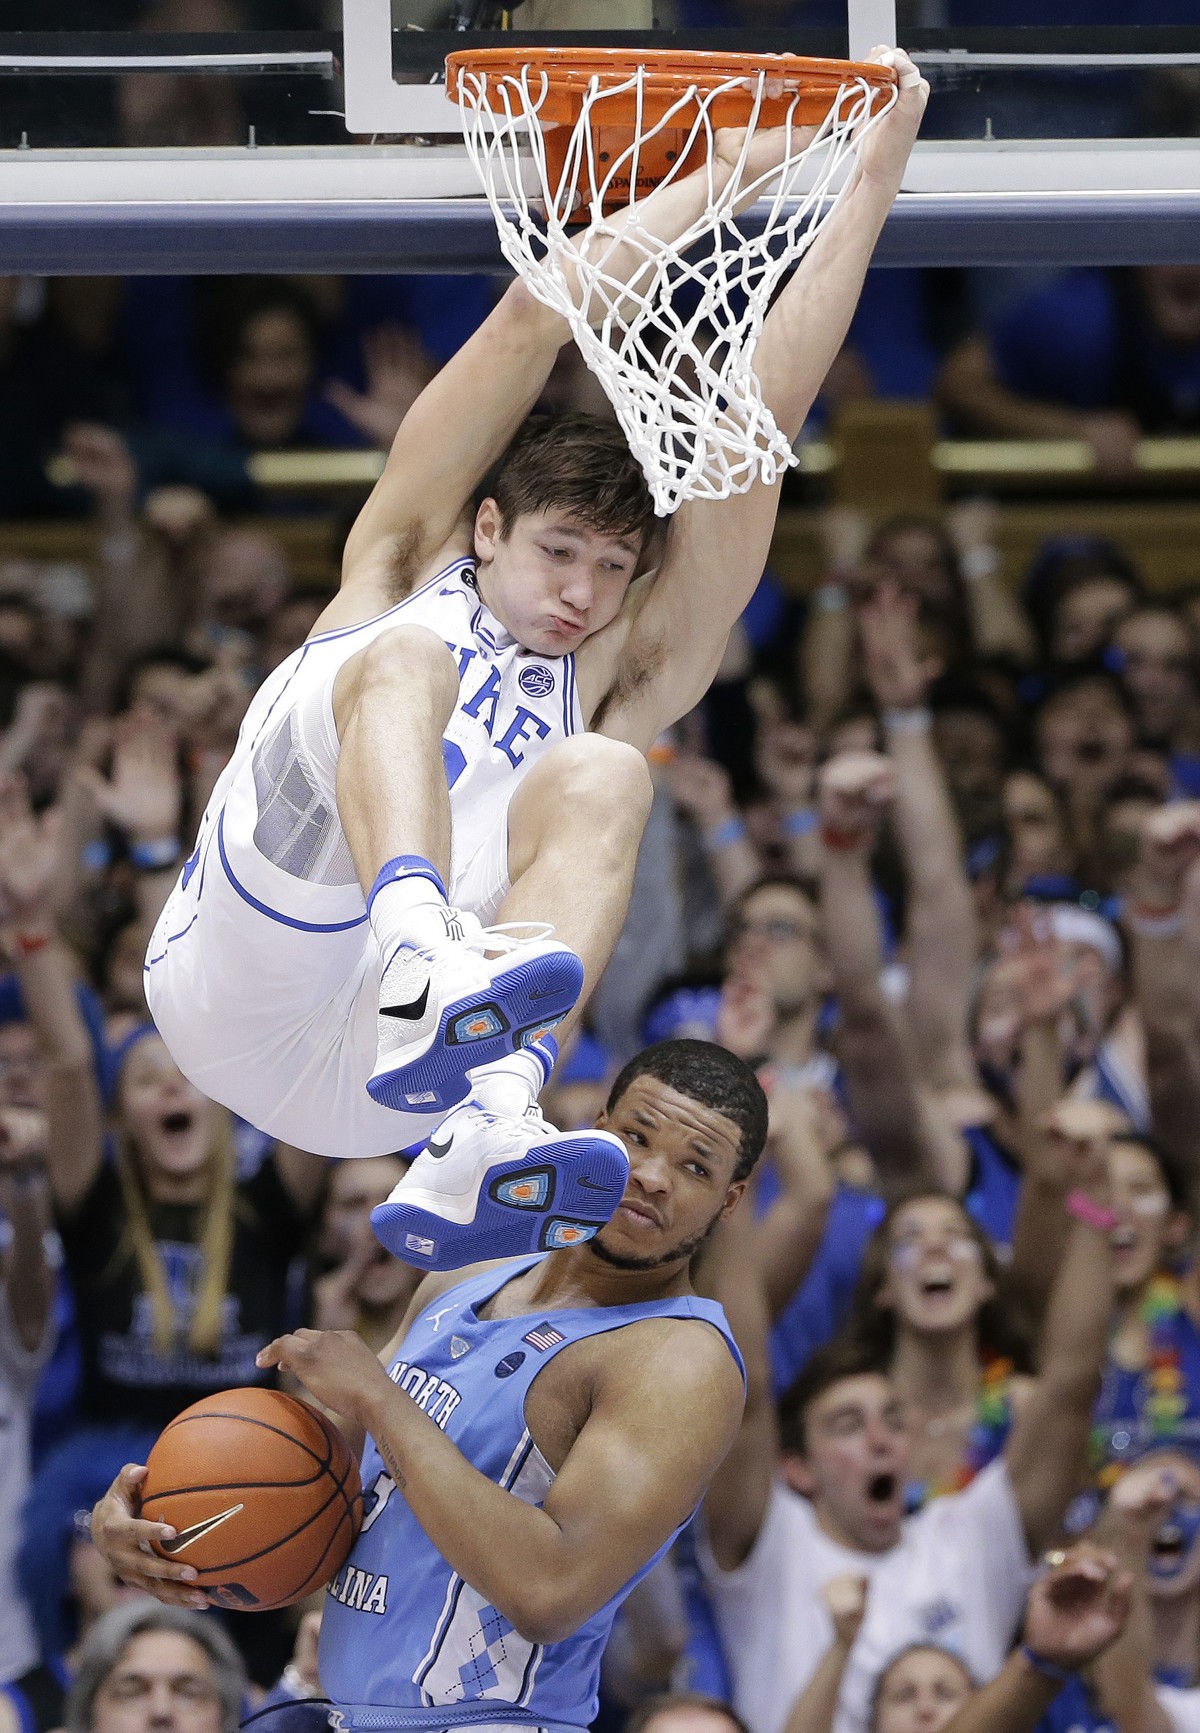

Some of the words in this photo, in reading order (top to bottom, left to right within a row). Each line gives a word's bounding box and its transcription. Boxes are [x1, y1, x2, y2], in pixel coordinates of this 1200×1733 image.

[524, 674, 552, 685] ACC
[388, 1361, 462, 1432] NORTH
[328, 1565, 388, 1615] LINA
